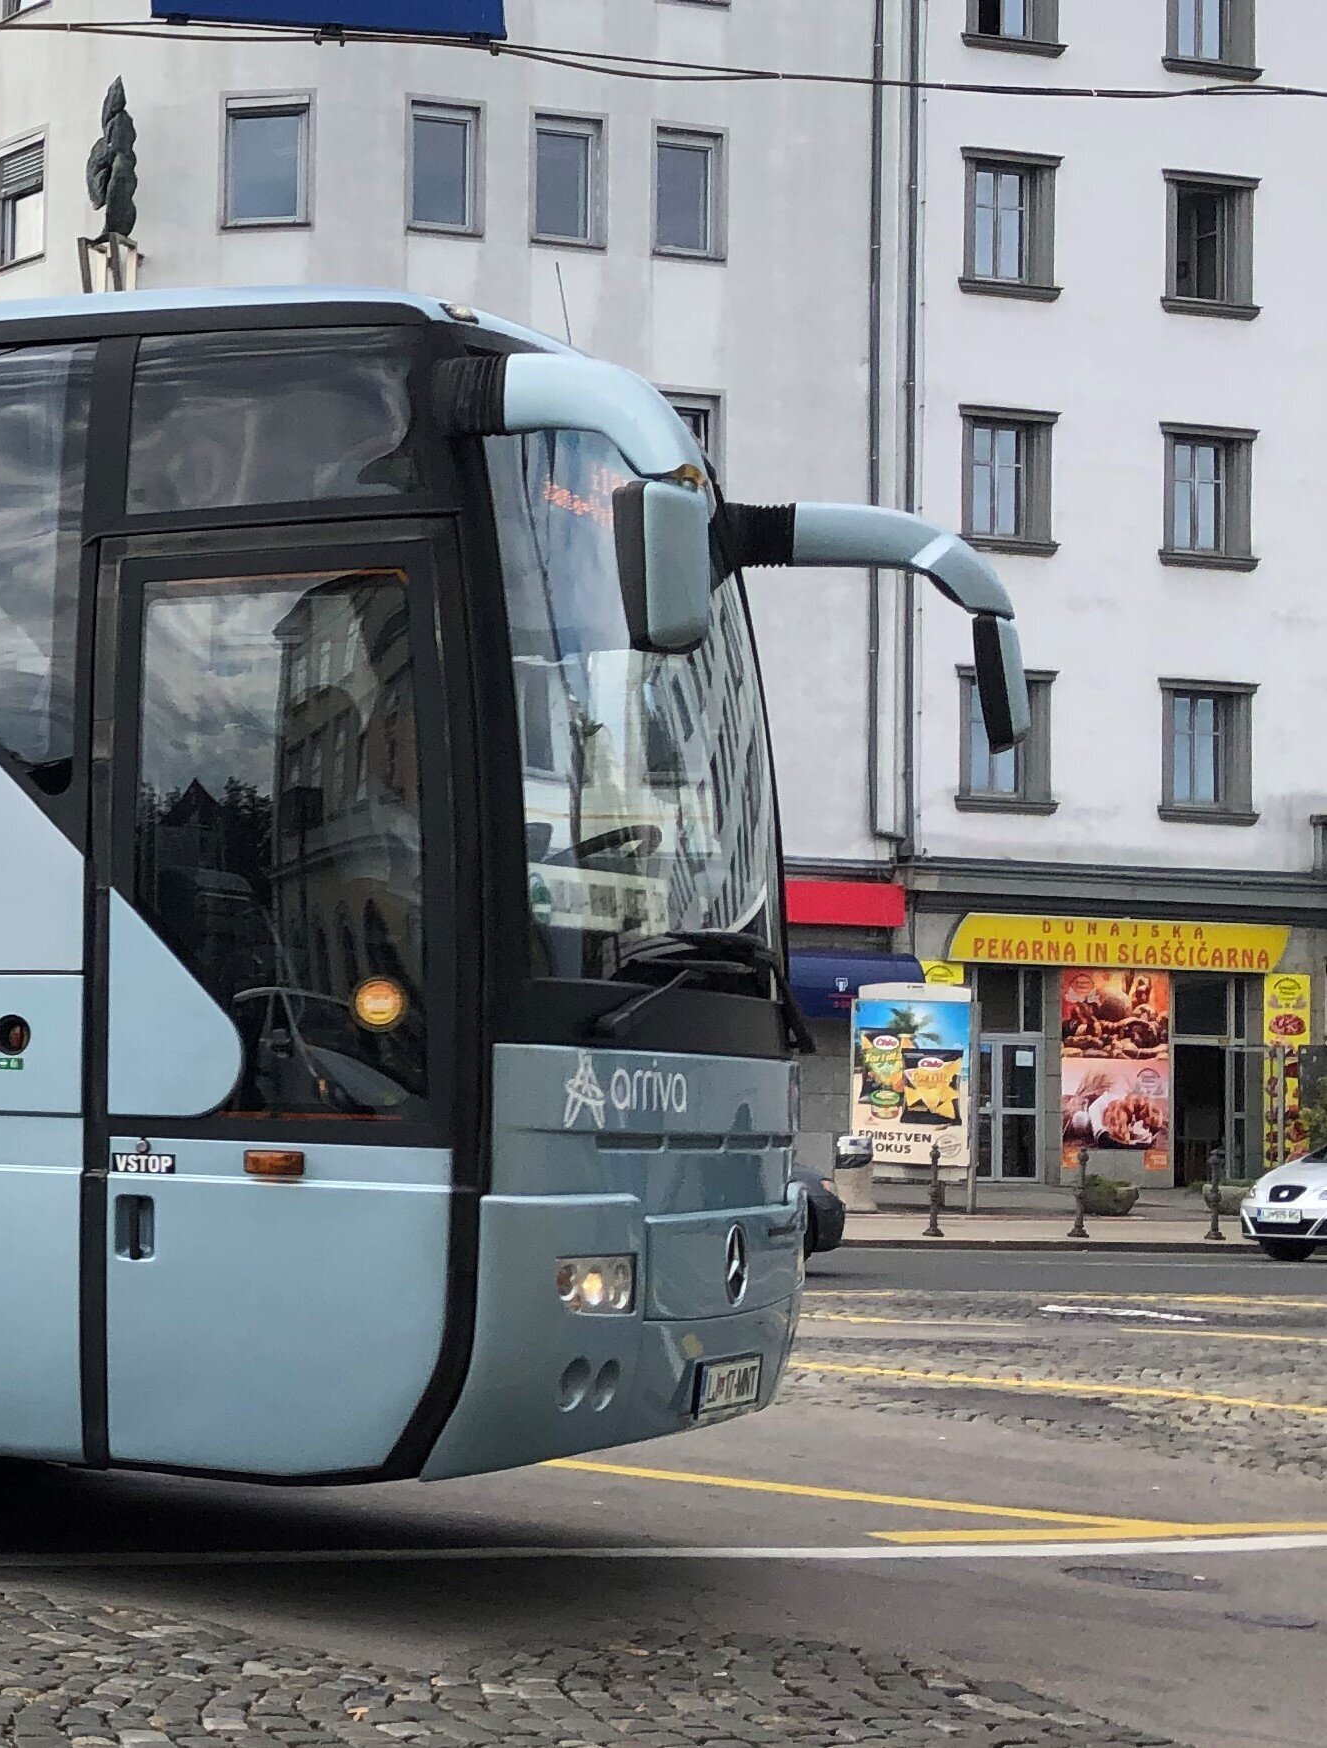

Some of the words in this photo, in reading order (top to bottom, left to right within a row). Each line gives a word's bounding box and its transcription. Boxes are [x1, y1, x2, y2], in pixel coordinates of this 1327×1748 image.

[1042, 920, 1203, 940] DUNAJSKA
[973, 937, 1077, 962] PEKARNA
[1086, 942, 1108, 963] IN
[1118, 939, 1270, 969] SLAŠČIČARNA
[610, 1058, 687, 1113] arriva
[115, 1154, 173, 1173] VSTOP
